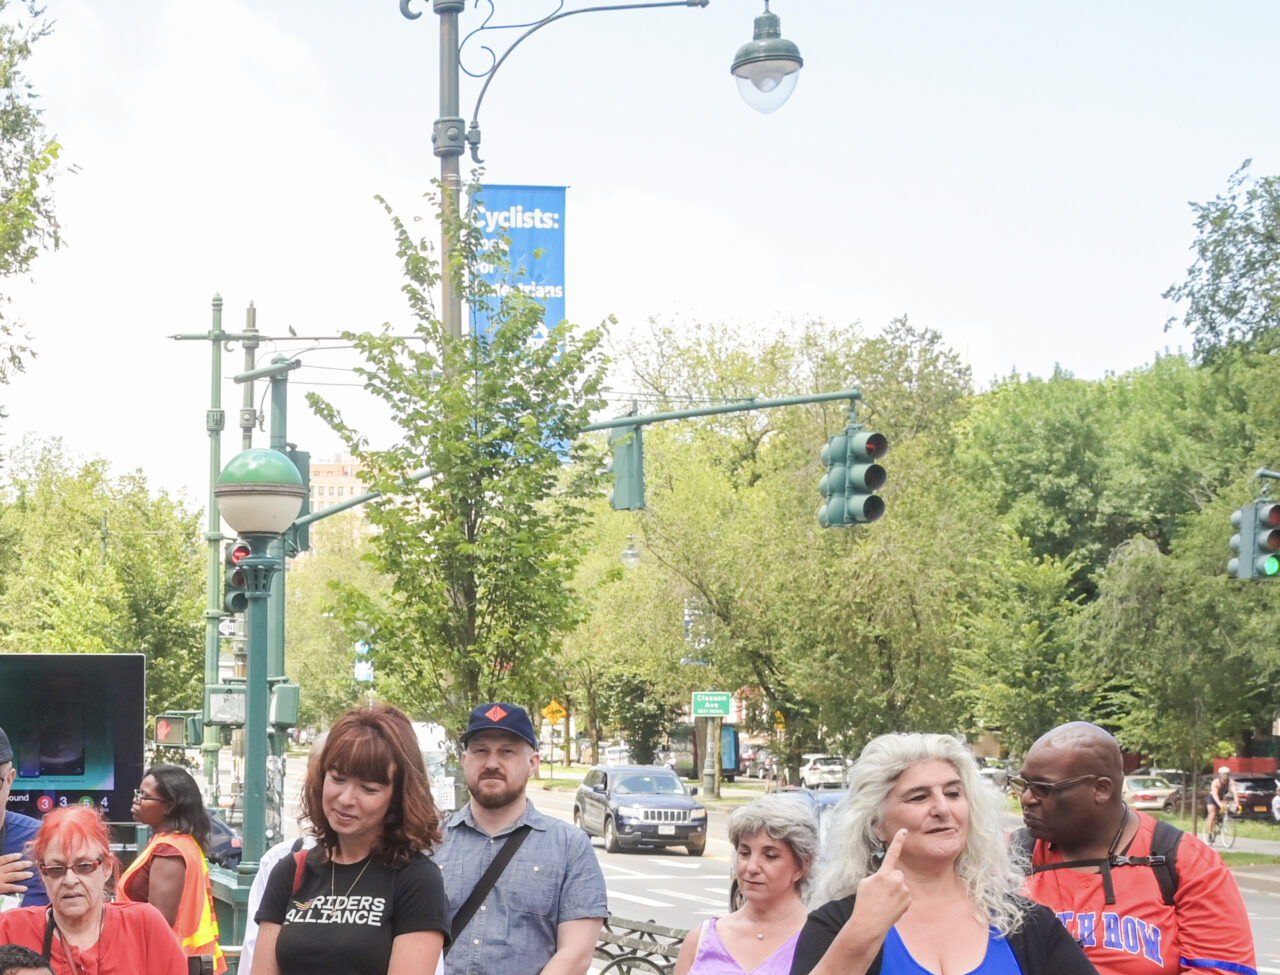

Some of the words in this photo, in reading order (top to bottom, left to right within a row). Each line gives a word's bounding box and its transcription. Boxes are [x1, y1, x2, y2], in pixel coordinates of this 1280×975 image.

[471, 205, 559, 233] Cyclists:
[41, 799, 49, 809] 3
[60, 796, 67, 807] 3
[100, 796, 109, 807] 4
[311, 895, 386, 911] RIDERS
[285, 909, 383, 926] ALLIANCE
[1102, 911, 1164, 968] ROW
